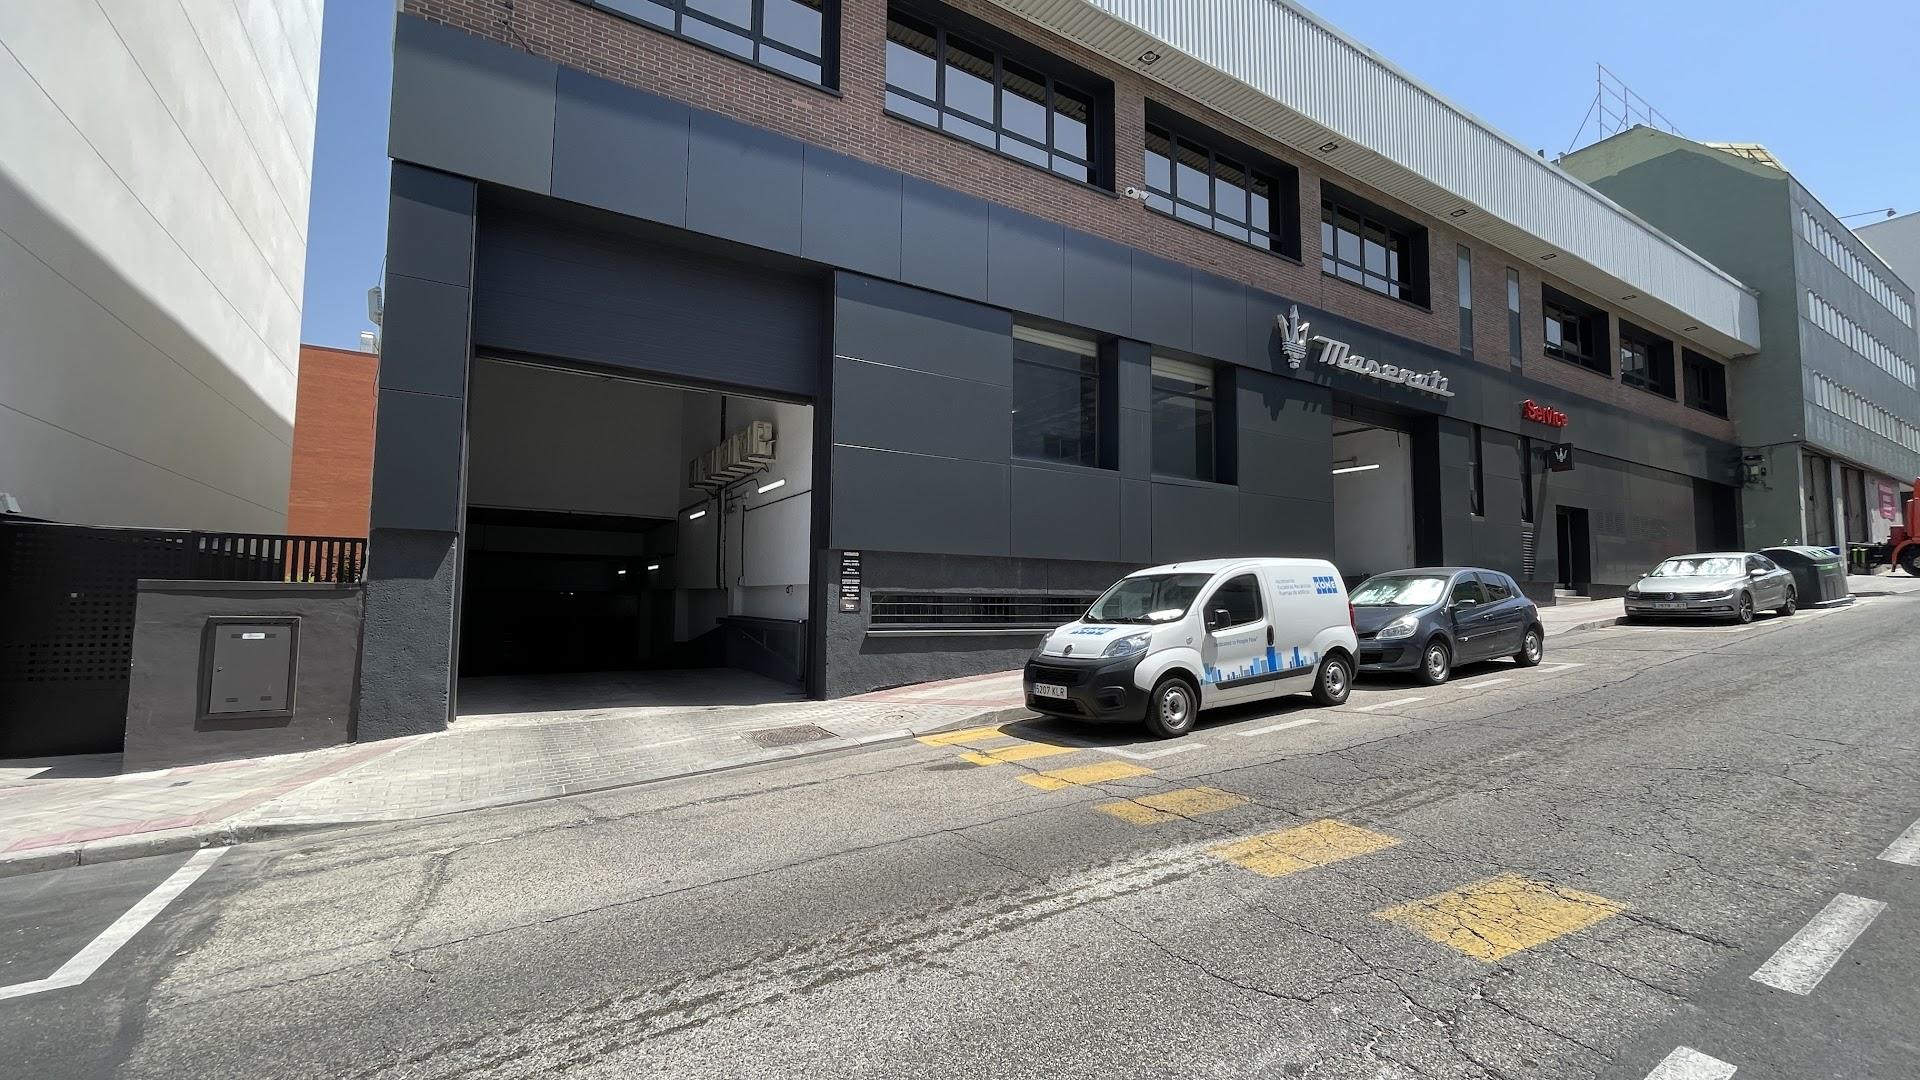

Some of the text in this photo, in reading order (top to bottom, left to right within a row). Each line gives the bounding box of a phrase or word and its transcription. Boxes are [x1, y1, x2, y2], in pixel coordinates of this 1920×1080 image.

[1308, 335, 1455, 397] Maserati
[1523, 399, 1568, 427] Service
[1036, 684, 1050, 694] 5207
